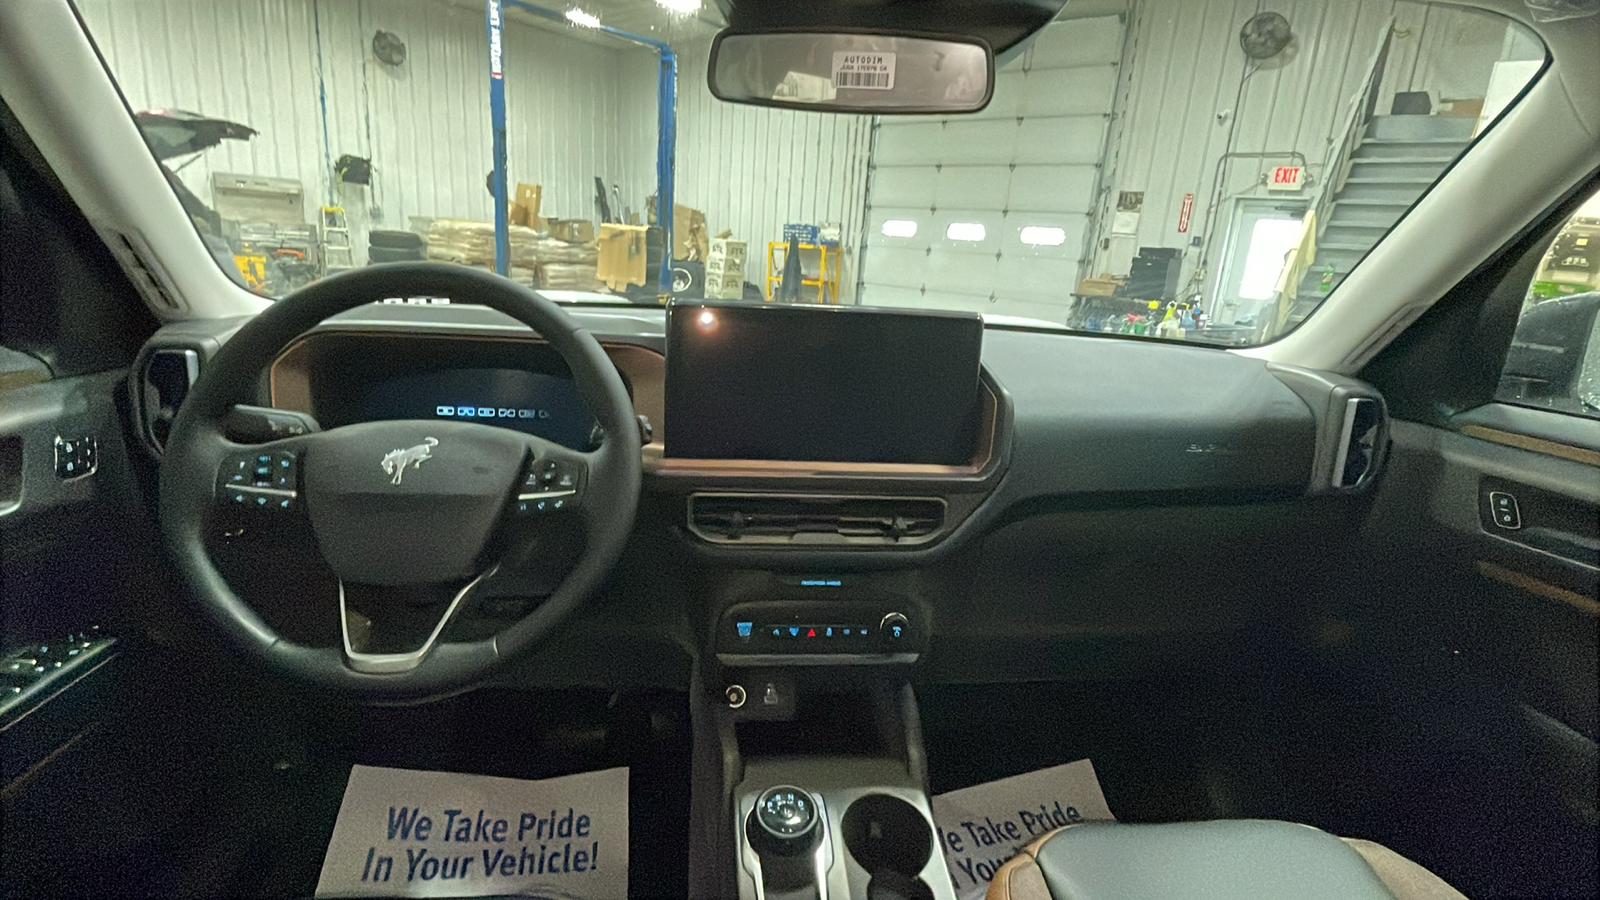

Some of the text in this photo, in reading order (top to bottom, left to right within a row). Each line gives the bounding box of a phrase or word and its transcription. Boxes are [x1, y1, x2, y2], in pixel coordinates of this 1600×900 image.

[844, 56, 883, 64] AUTODIM
[1274, 167, 1300, 183] EXIT
[387, 806, 590, 843] We Take Pride
[961, 817, 1021, 848] Take
[1019, 801, 1082, 835] Pride
[361, 841, 599, 882] In Your Vehicle!
